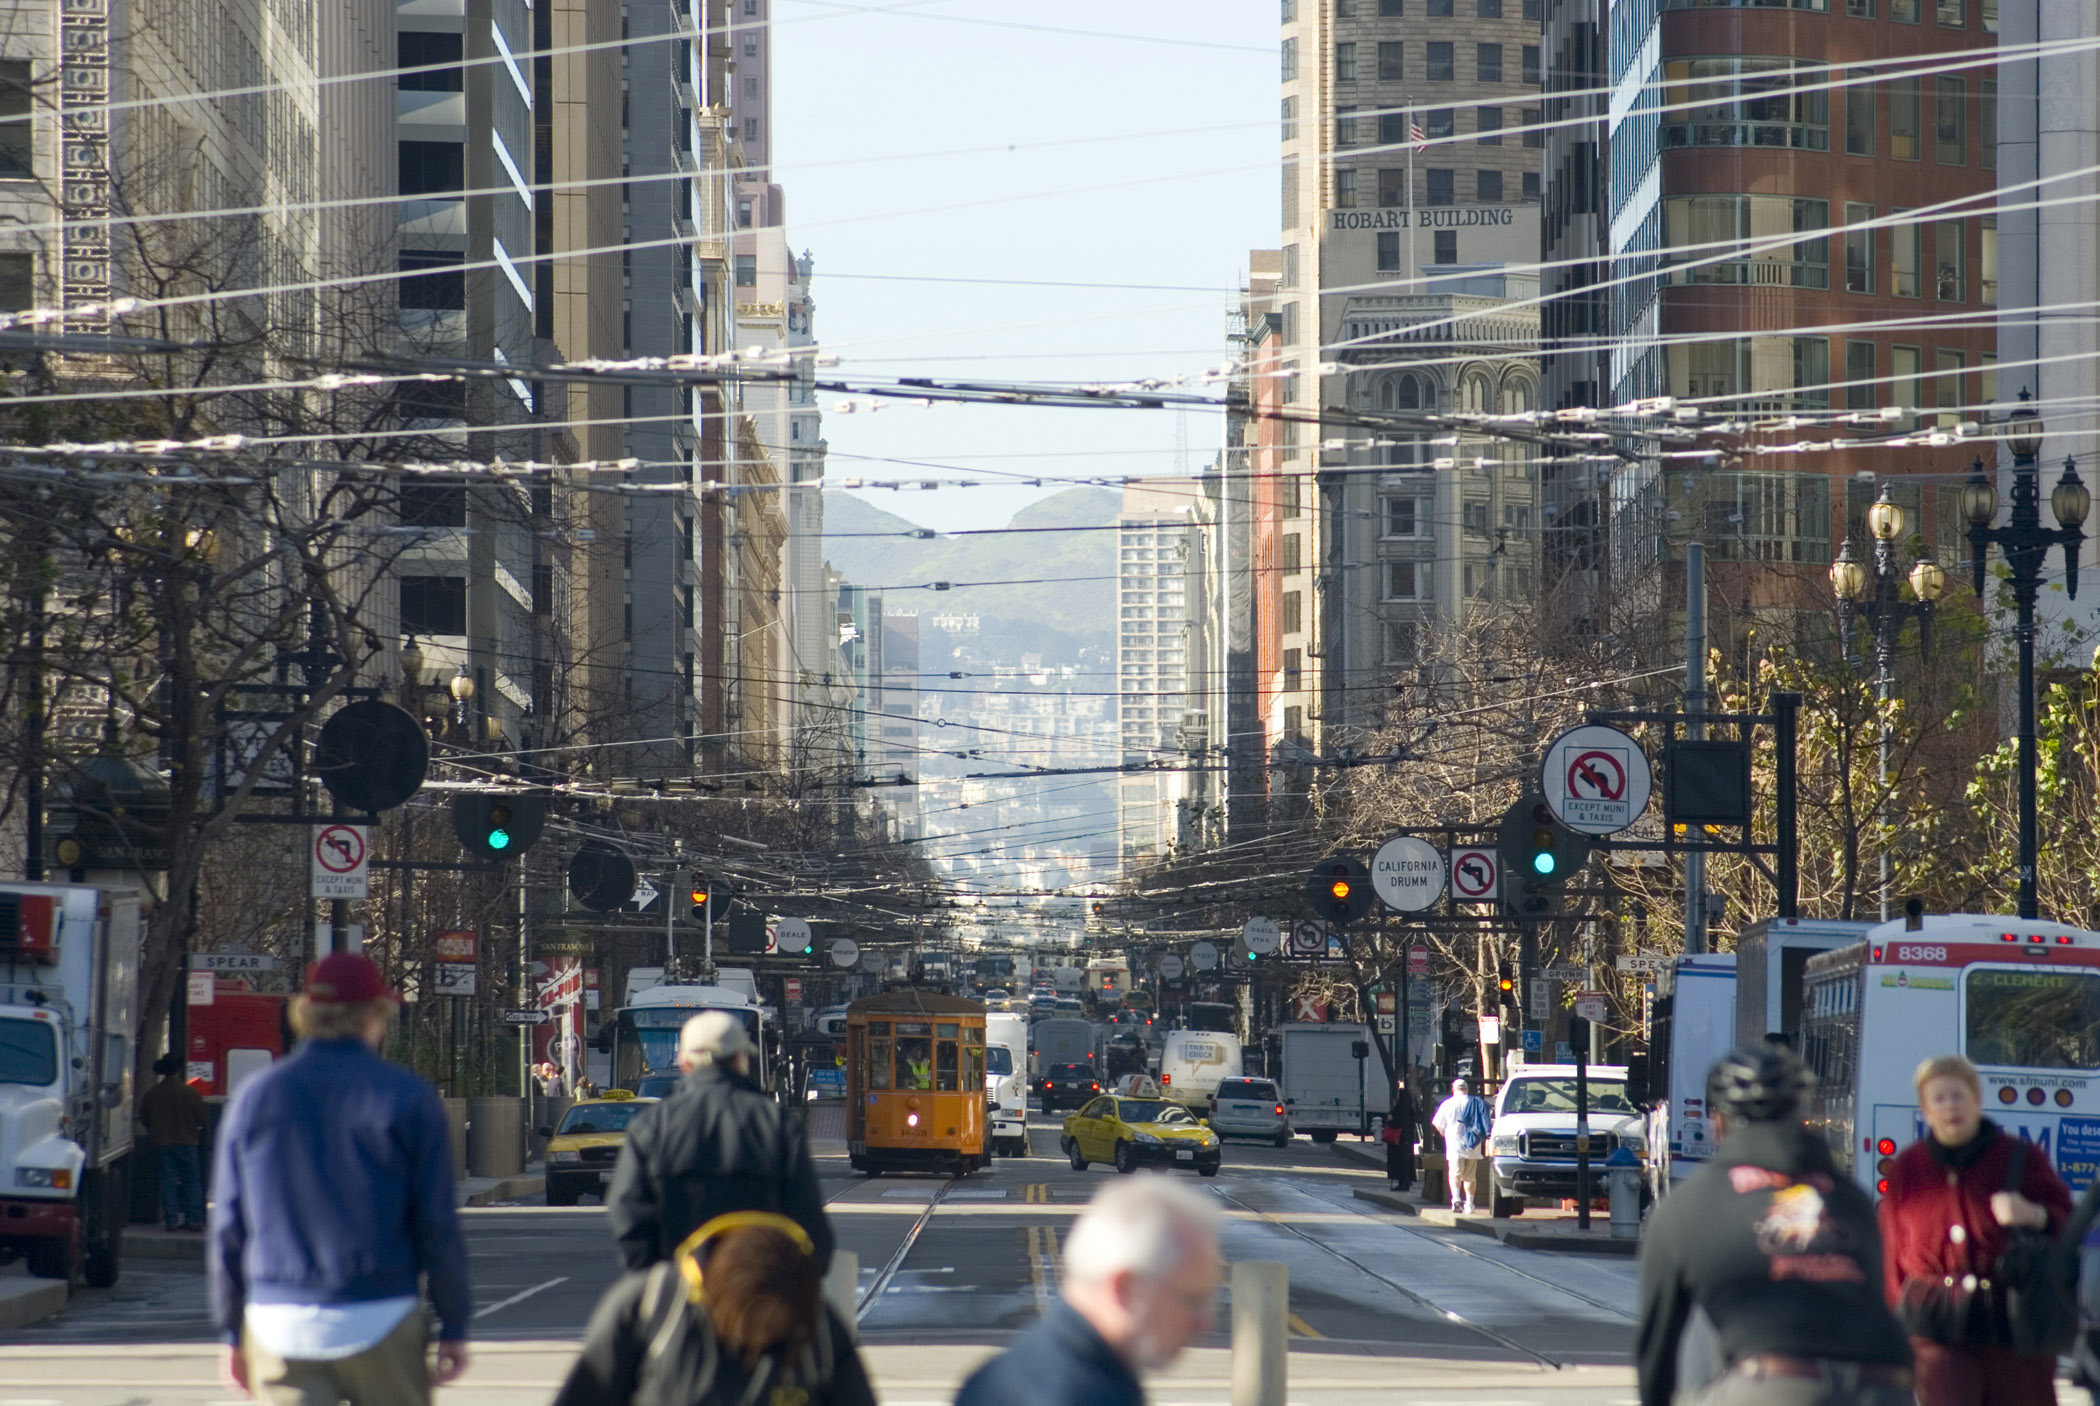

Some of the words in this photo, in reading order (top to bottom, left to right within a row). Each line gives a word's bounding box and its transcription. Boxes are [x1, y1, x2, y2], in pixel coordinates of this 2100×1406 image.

[1333, 211, 1410, 229] HOBART
[1419, 209, 1514, 227] BUILDING
[1568, 802, 1601, 813] EXCEPT
[1603, 803, 1625, 813] MUNI
[1579, 813, 1585, 822] &
[1589, 812, 1614, 822] TAXIS
[1378, 860, 1439, 872] CALIFORNIA
[316, 875, 344, 884] EXCEPT
[1390, 875, 1428, 887] DRUMM
[334, 885, 355, 894] TAXIS
[1899, 945, 1948, 961] 8368
[206, 956, 260, 968] SPEAR
[1972, 974, 1982, 986] 2
[1993, 974, 2066, 988] CLEMENT
[1536, 984, 1544, 993] NO
[1188, 1051, 1214, 1059] CHUCK
[1988, 1075, 2087, 1089] www.sfmuni.com
[2061, 1123, 2080, 1137] You
